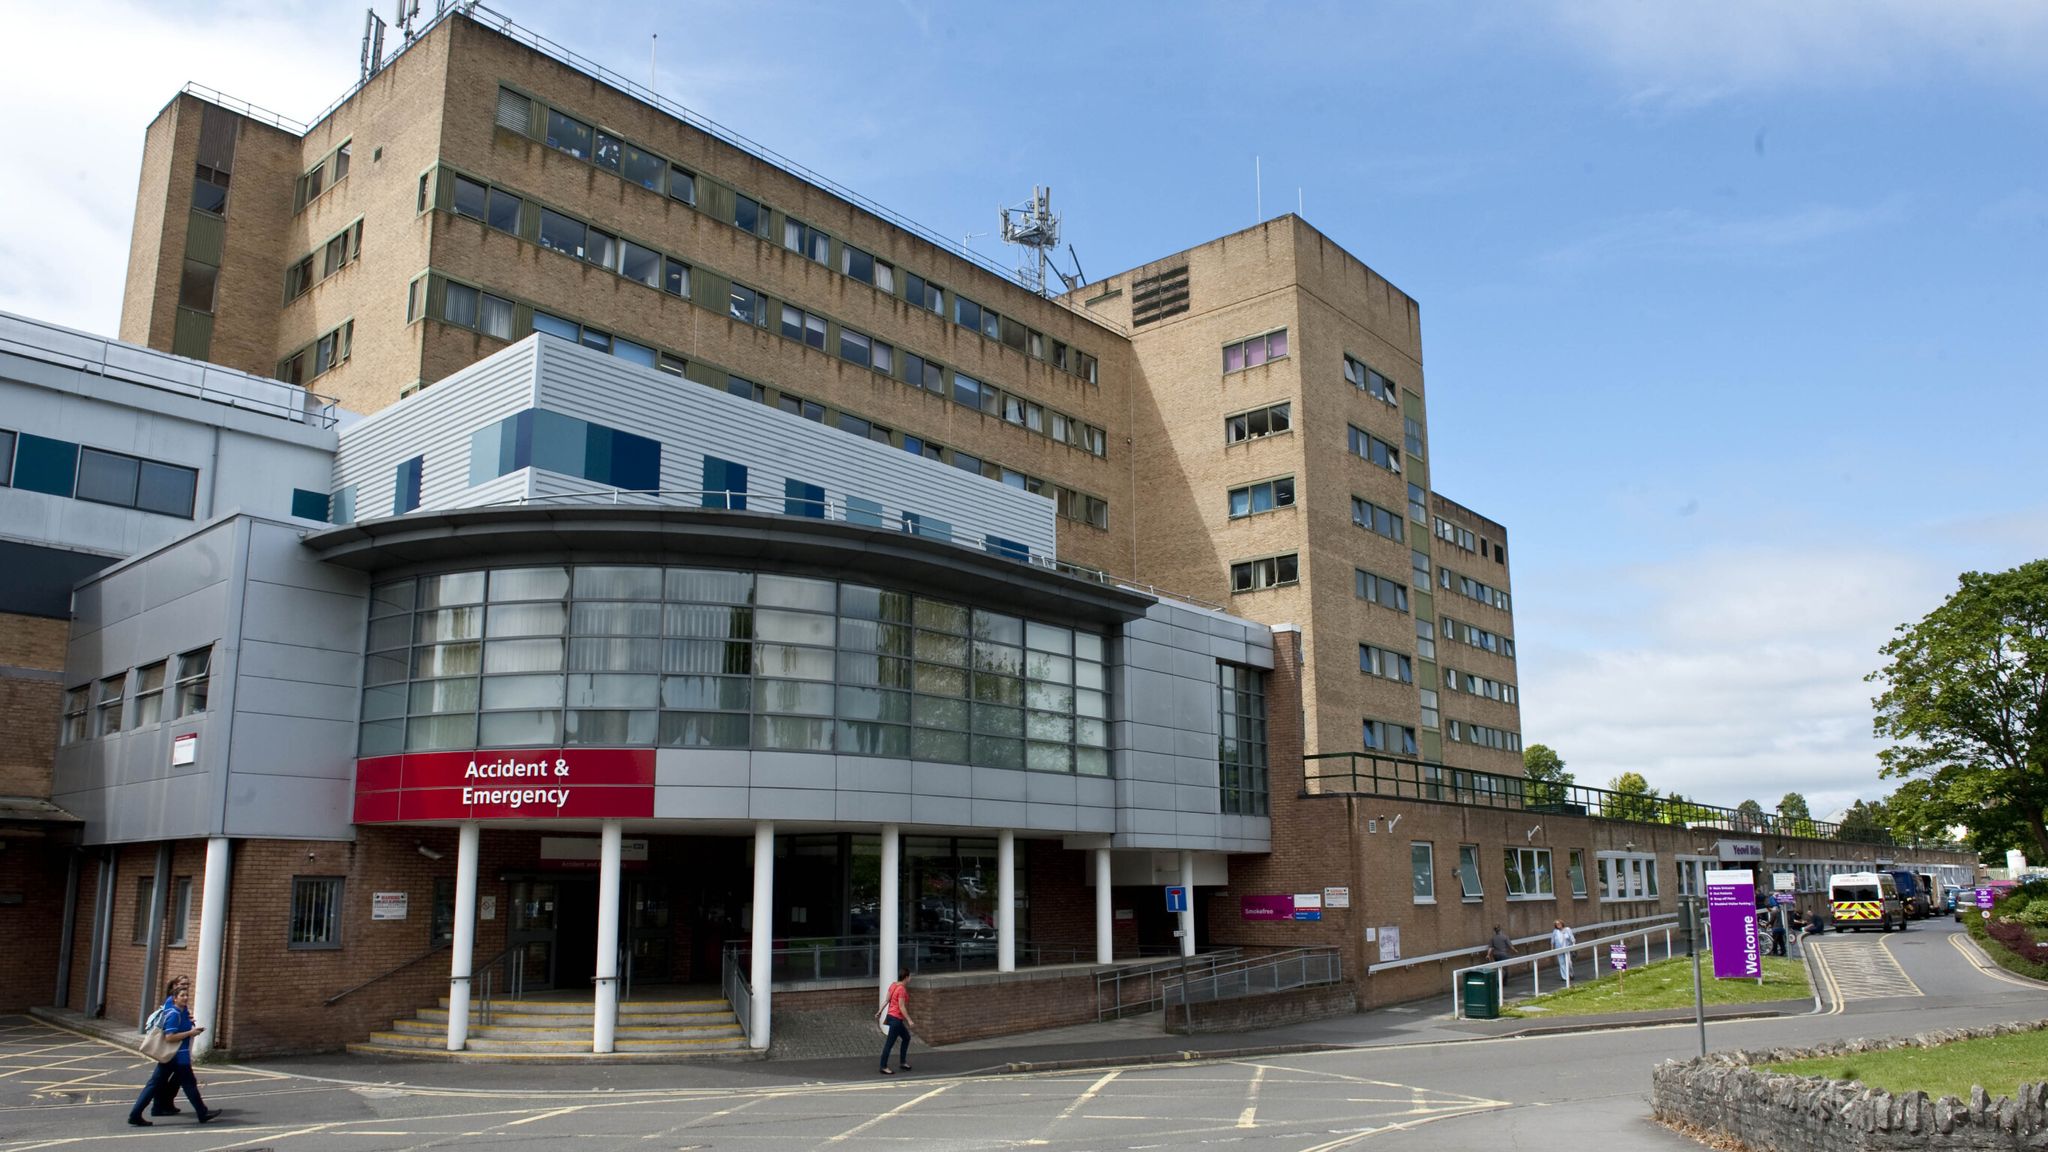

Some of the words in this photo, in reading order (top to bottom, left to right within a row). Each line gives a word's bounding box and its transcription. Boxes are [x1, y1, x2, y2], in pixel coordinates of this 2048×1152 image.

[464, 758, 548, 778] Accident
[554, 758, 570, 776] &
[462, 787, 570, 808] Emergency
[1743, 915, 1758, 974] Welcome
